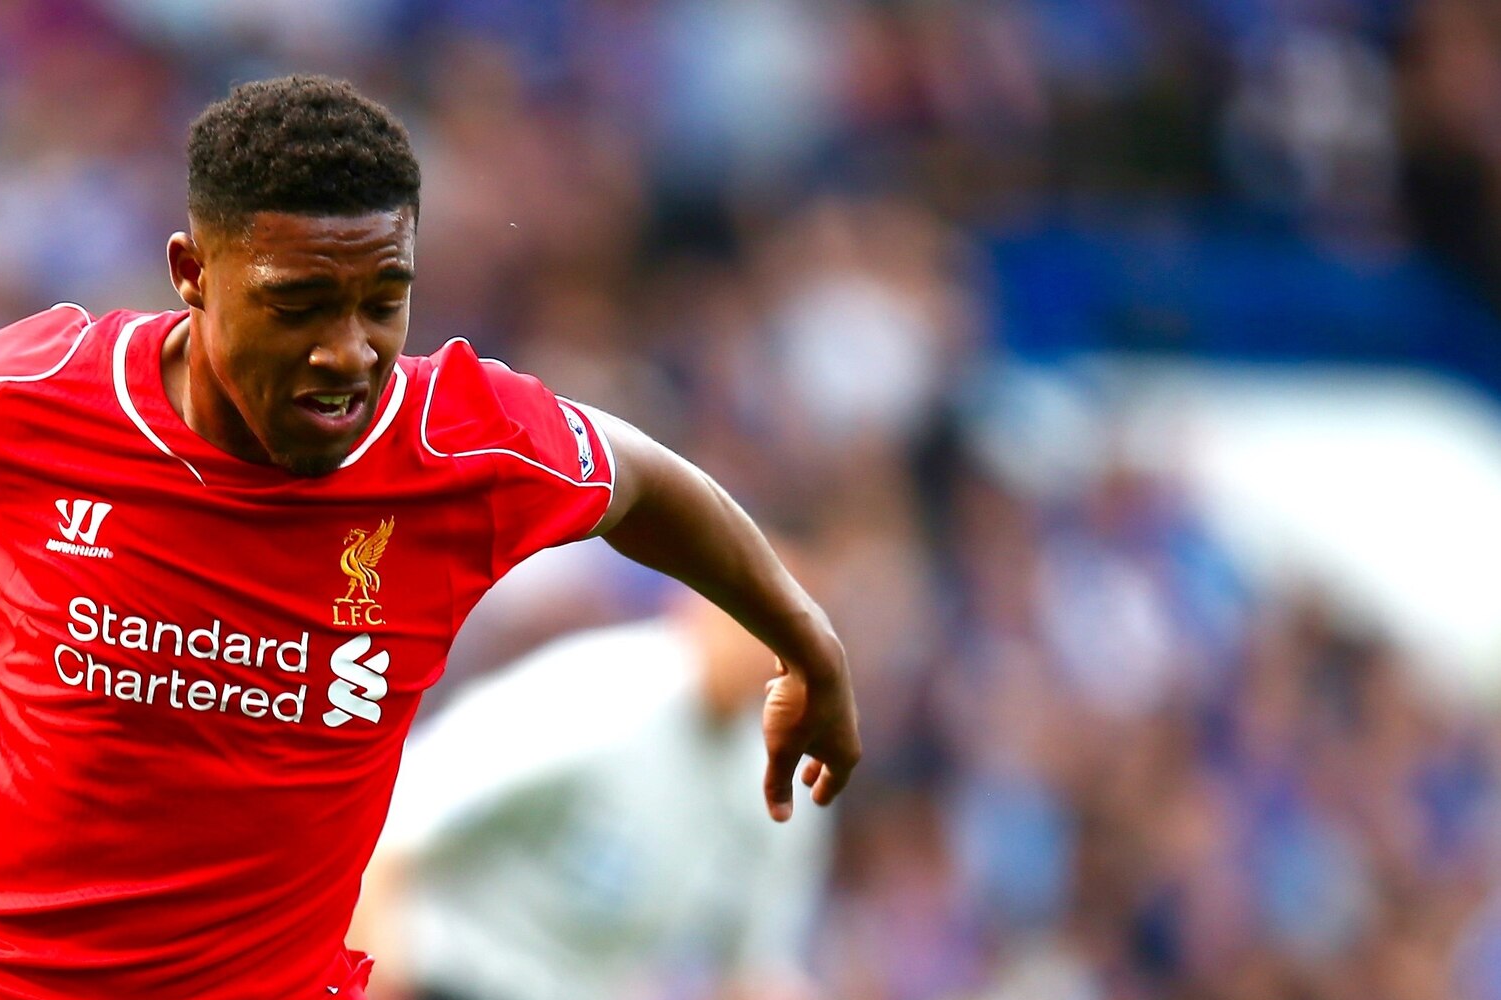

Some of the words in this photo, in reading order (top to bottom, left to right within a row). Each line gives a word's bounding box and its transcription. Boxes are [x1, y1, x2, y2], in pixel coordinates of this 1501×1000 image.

[45, 538, 111, 559] WARRIOR
[67, 596, 310, 673] Standard
[332, 604, 387, 626] L.F.C.
[53, 643, 308, 723] Chartered
